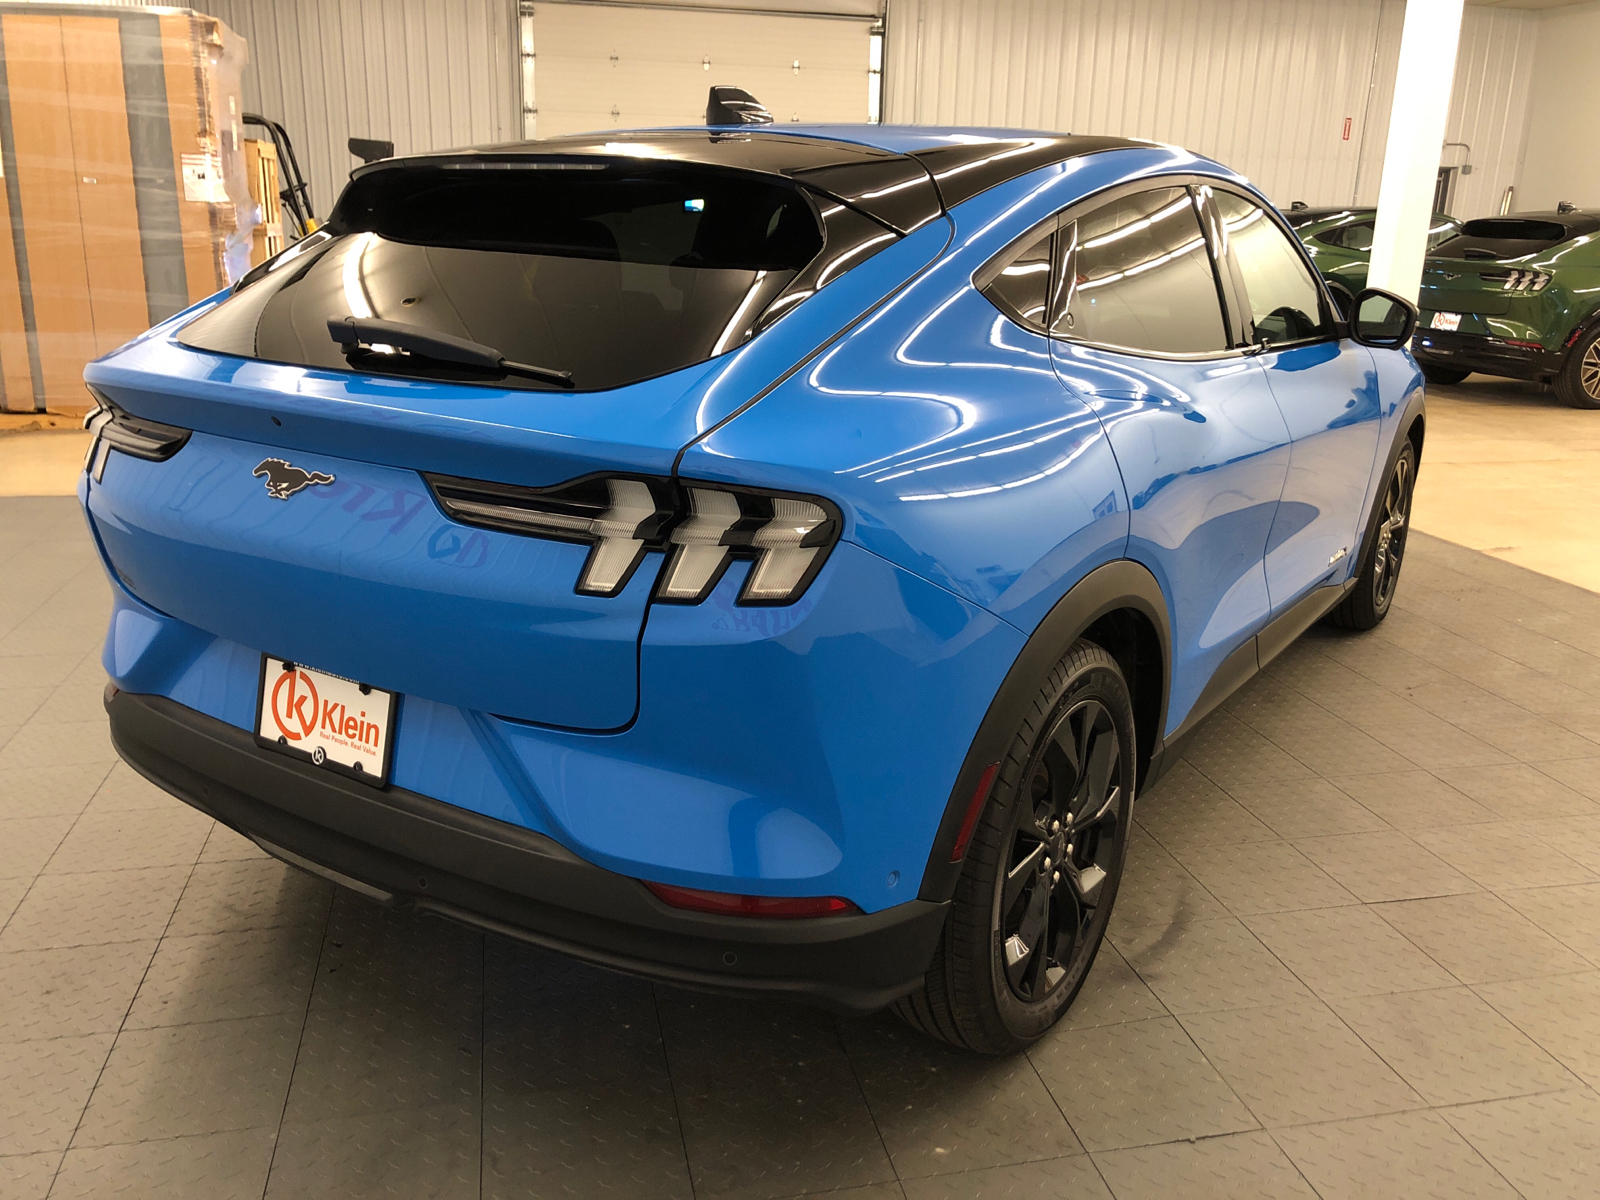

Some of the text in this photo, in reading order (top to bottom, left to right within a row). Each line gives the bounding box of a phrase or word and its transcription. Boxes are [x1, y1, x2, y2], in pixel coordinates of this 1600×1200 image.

[320, 698, 380, 748] Klein
[319, 730, 378, 757] Real People. Real Value.
